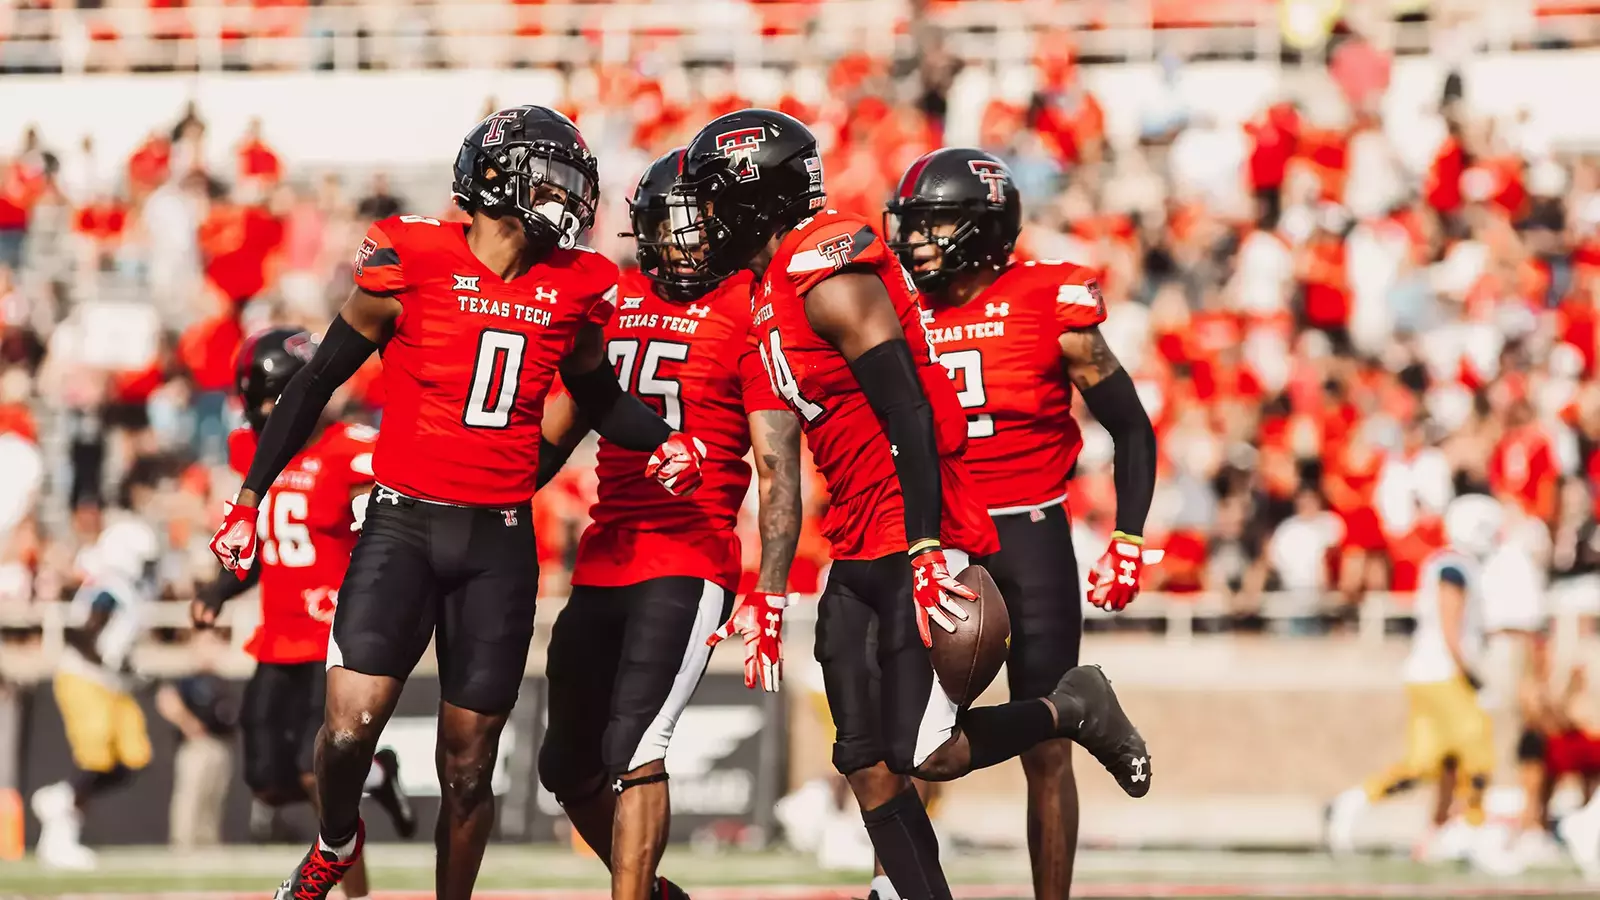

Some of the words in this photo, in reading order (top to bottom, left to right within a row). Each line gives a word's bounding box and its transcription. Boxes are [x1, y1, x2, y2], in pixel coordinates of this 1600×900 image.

[457, 295, 511, 318] TEXAS
[514, 303, 552, 327] TECH
[619, 314, 659, 329] TEXAS
[661, 315, 699, 334] TECH
[927, 325, 963, 344] EXAS
[964, 321, 1004, 340] TECH
[463, 328, 528, 429] 0
[938, 349, 996, 438] 2
